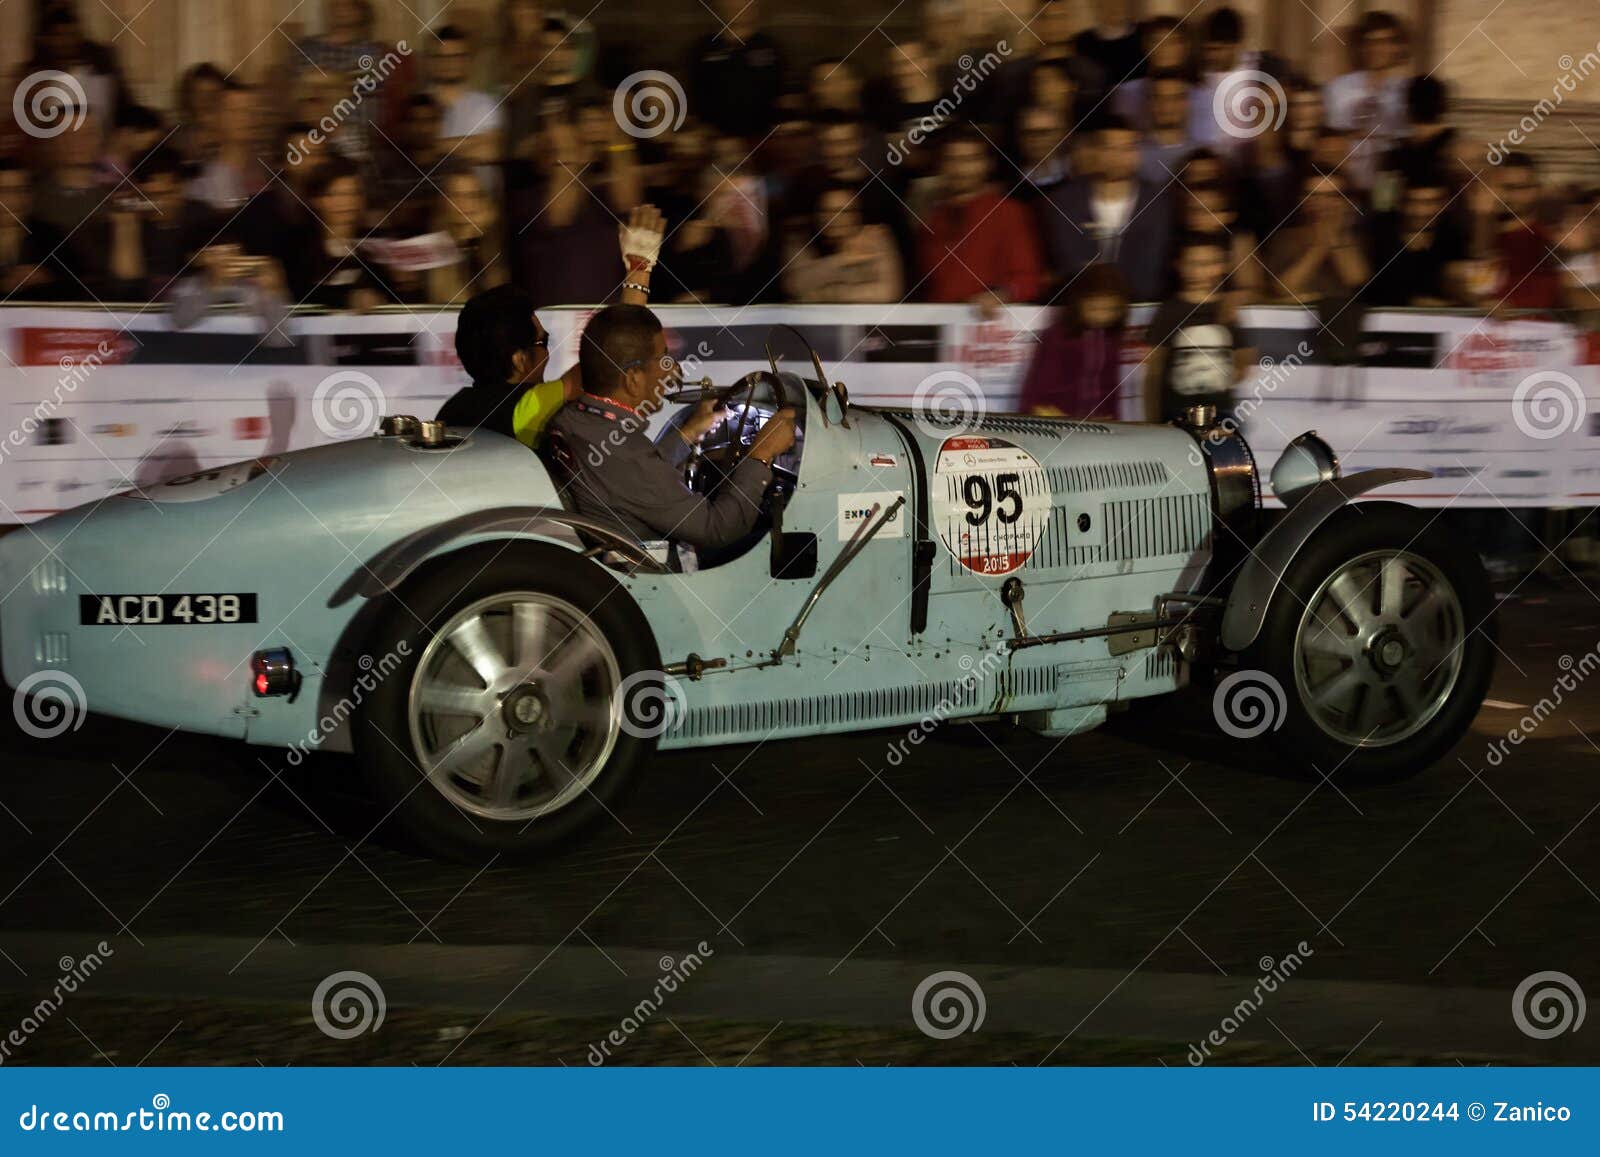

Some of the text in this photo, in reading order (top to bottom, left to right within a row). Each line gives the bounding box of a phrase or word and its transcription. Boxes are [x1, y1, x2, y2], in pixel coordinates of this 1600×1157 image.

[964, 473, 1024, 527] 95
[844, 508, 872, 520] EXPO
[983, 555, 1011, 574] 2015
[96, 594, 241, 625] ACD 438
